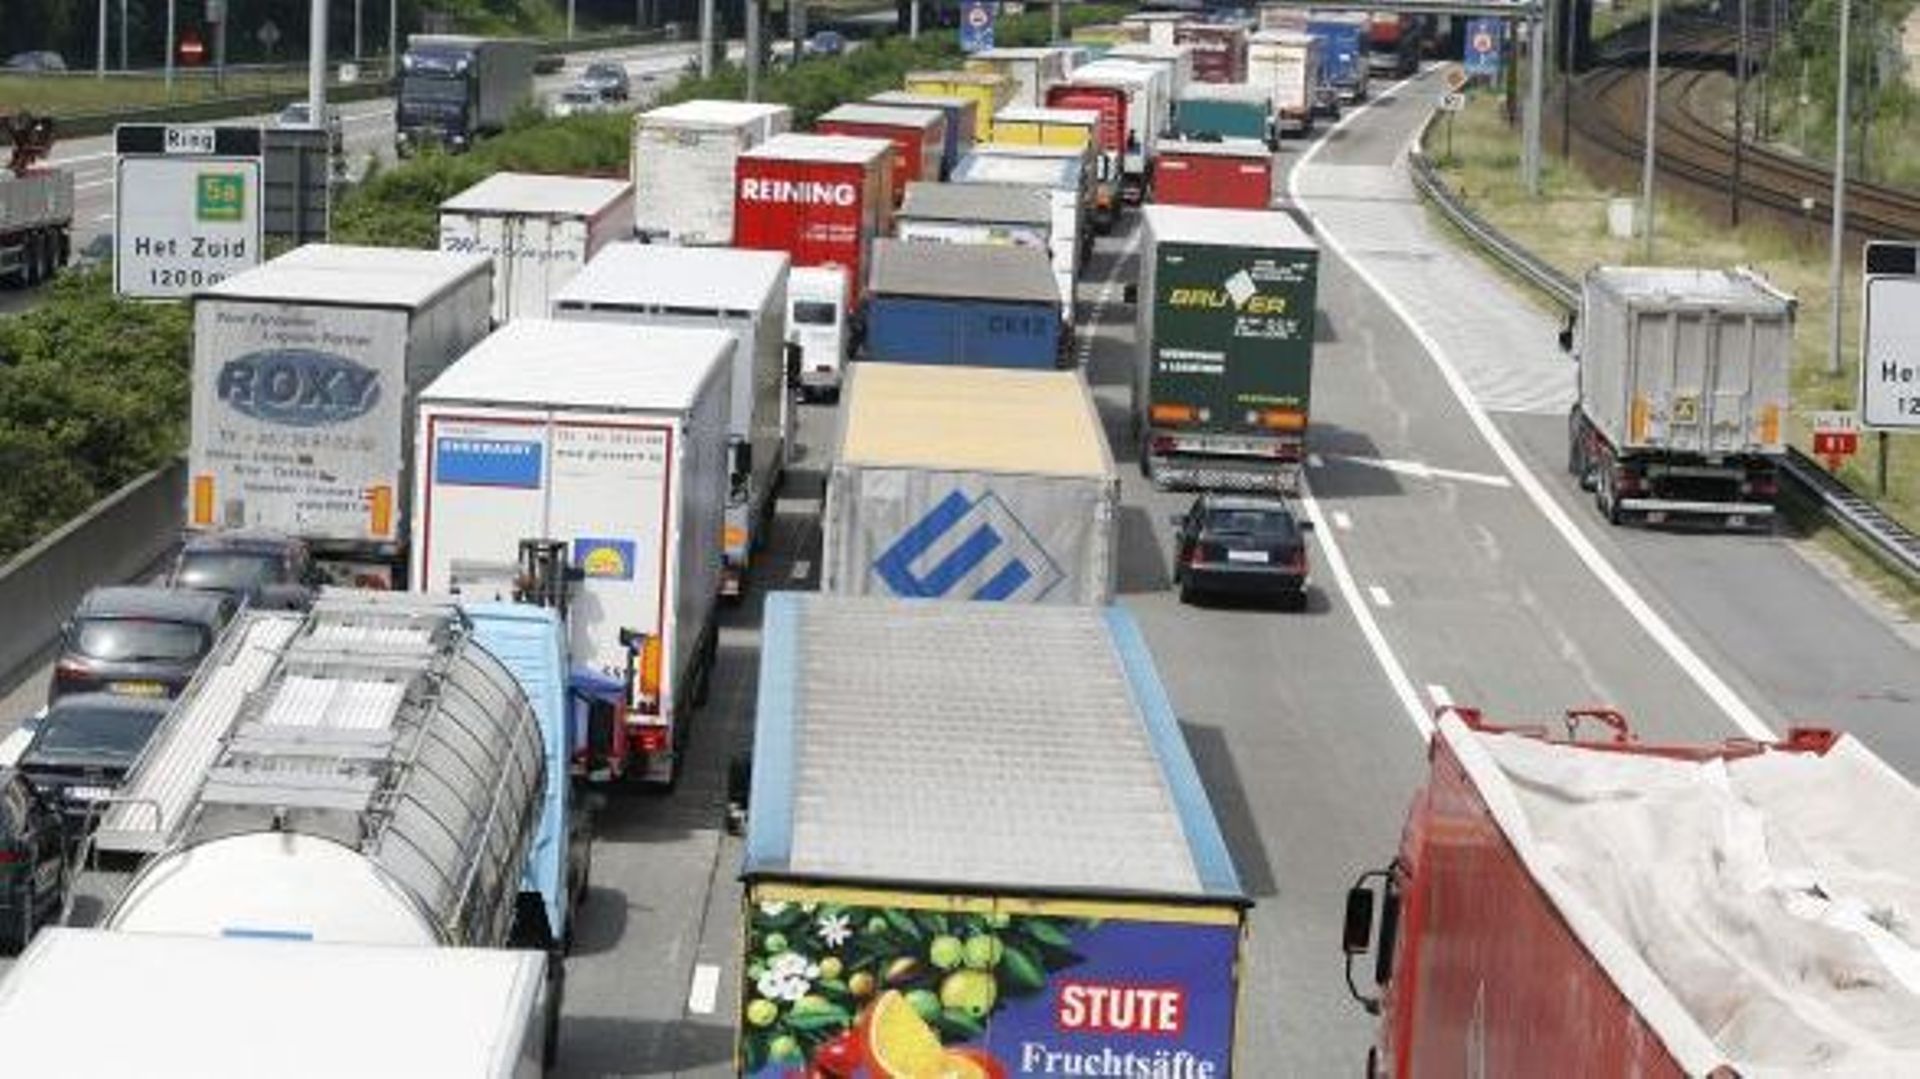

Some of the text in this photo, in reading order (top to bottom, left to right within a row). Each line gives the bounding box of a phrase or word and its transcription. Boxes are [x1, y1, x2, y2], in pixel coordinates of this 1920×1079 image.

[168, 129, 213, 150] Ring
[742, 177, 856, 206] REINING
[135, 237, 246, 257] Het Zuid
[218, 361, 380, 411] ROXY
[1881, 360, 1920, 383] He
[1060, 984, 1180, 1031] STUTE
[1021, 1040, 1216, 1079] Fruchtsäfte
